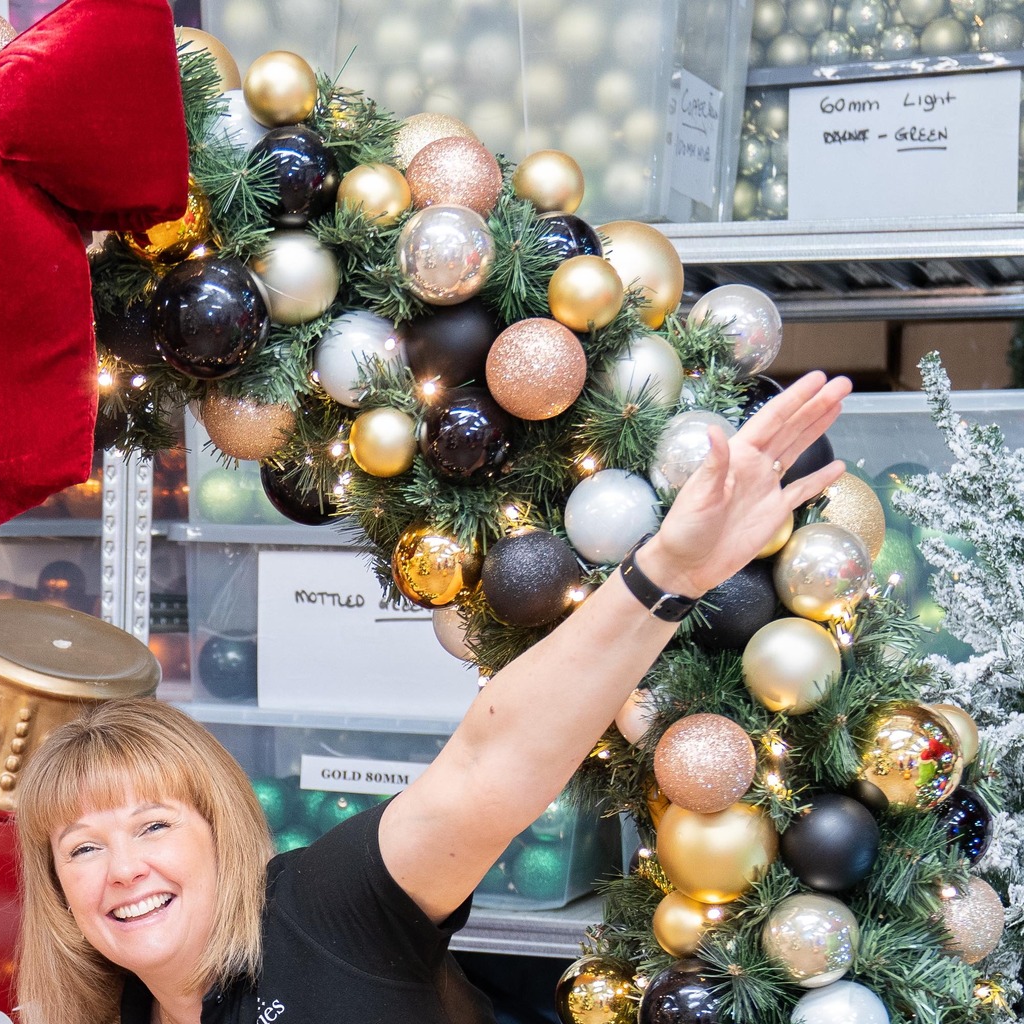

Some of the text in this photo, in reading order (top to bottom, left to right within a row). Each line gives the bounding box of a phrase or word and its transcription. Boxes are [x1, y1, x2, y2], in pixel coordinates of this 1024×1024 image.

[819, 91, 957, 114] 60mm Light
[895, 125, 948, 142] GREEN
[295, 590, 365, 608] MOTTLED
[321, 768, 409, 785] GOLD 80MM
